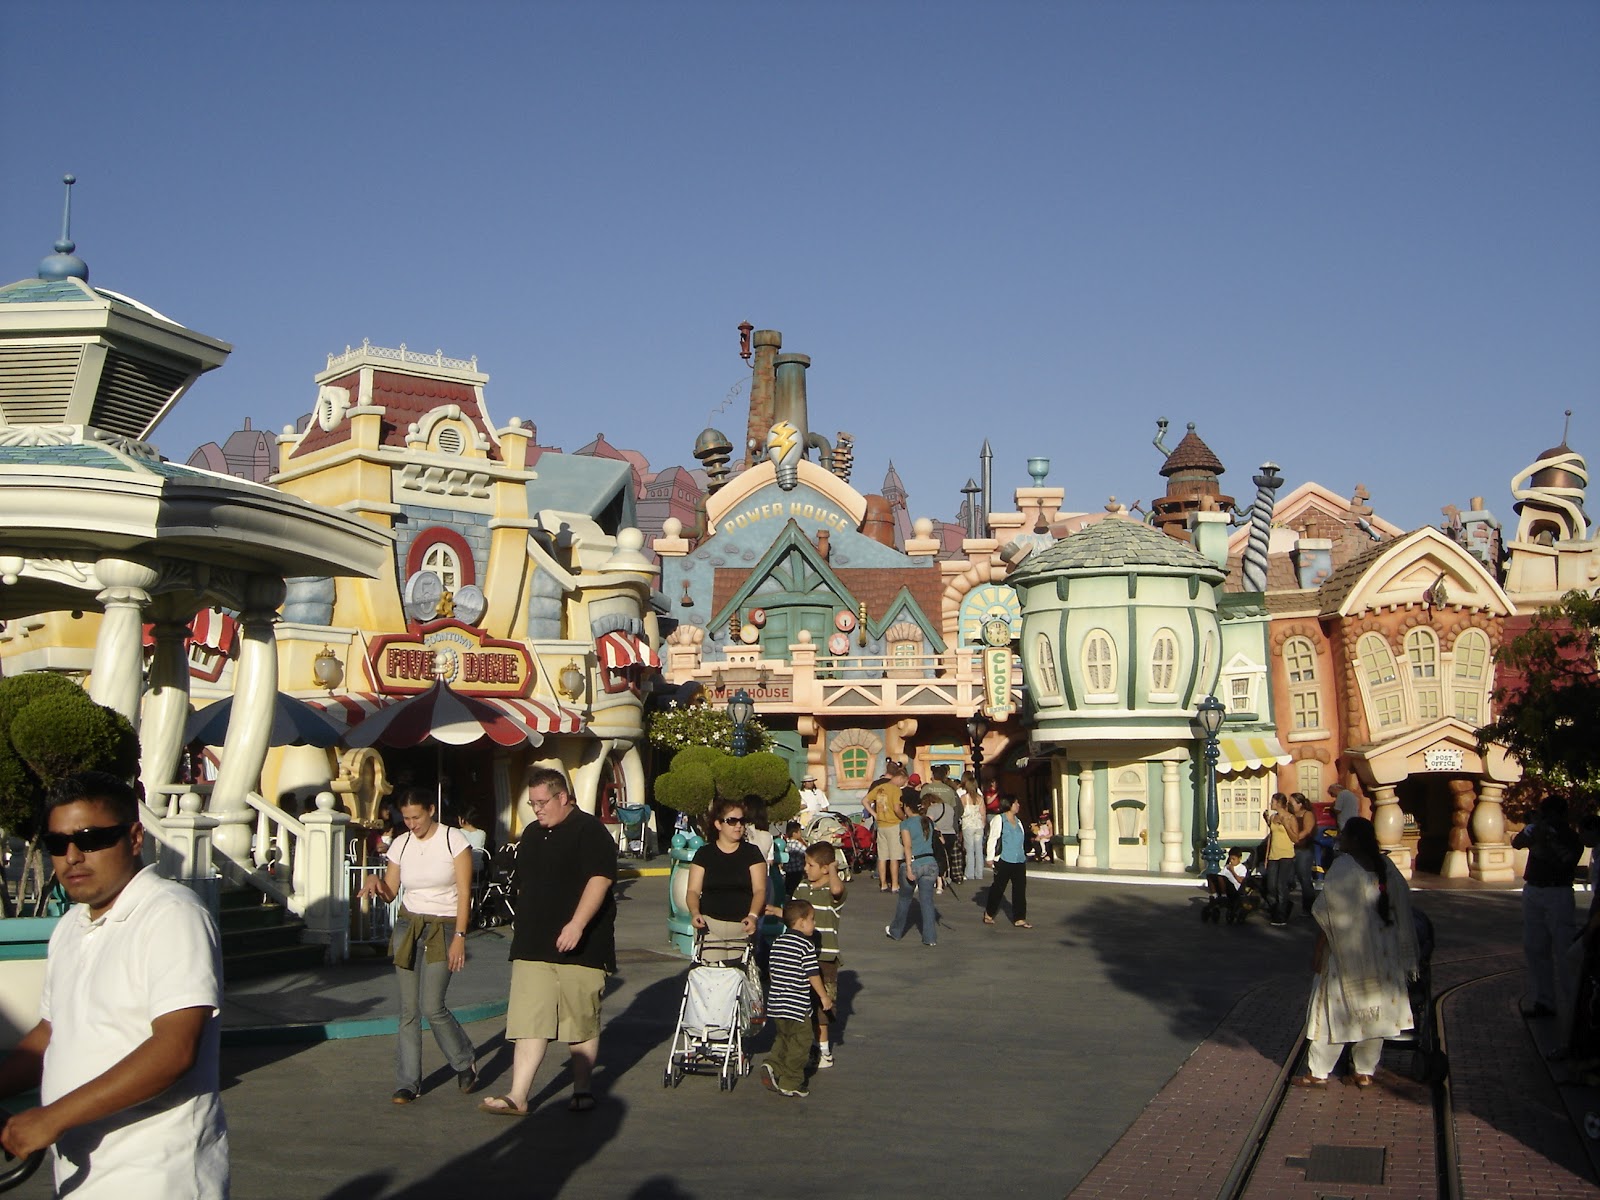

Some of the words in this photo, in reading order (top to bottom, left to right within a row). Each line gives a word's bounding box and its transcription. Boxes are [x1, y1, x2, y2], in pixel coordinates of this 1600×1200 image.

[724, 503, 784, 534] POWER
[790, 502, 848, 533] HOUSE
[424, 632, 474, 649] TOONTOWN
[387, 648, 436, 680] FIVE
[463, 652, 519, 683] DIME
[993, 652, 1006, 705] CLOCK
[709, 688, 741, 699] OWE
[748, 688, 789, 698] HOUSE
